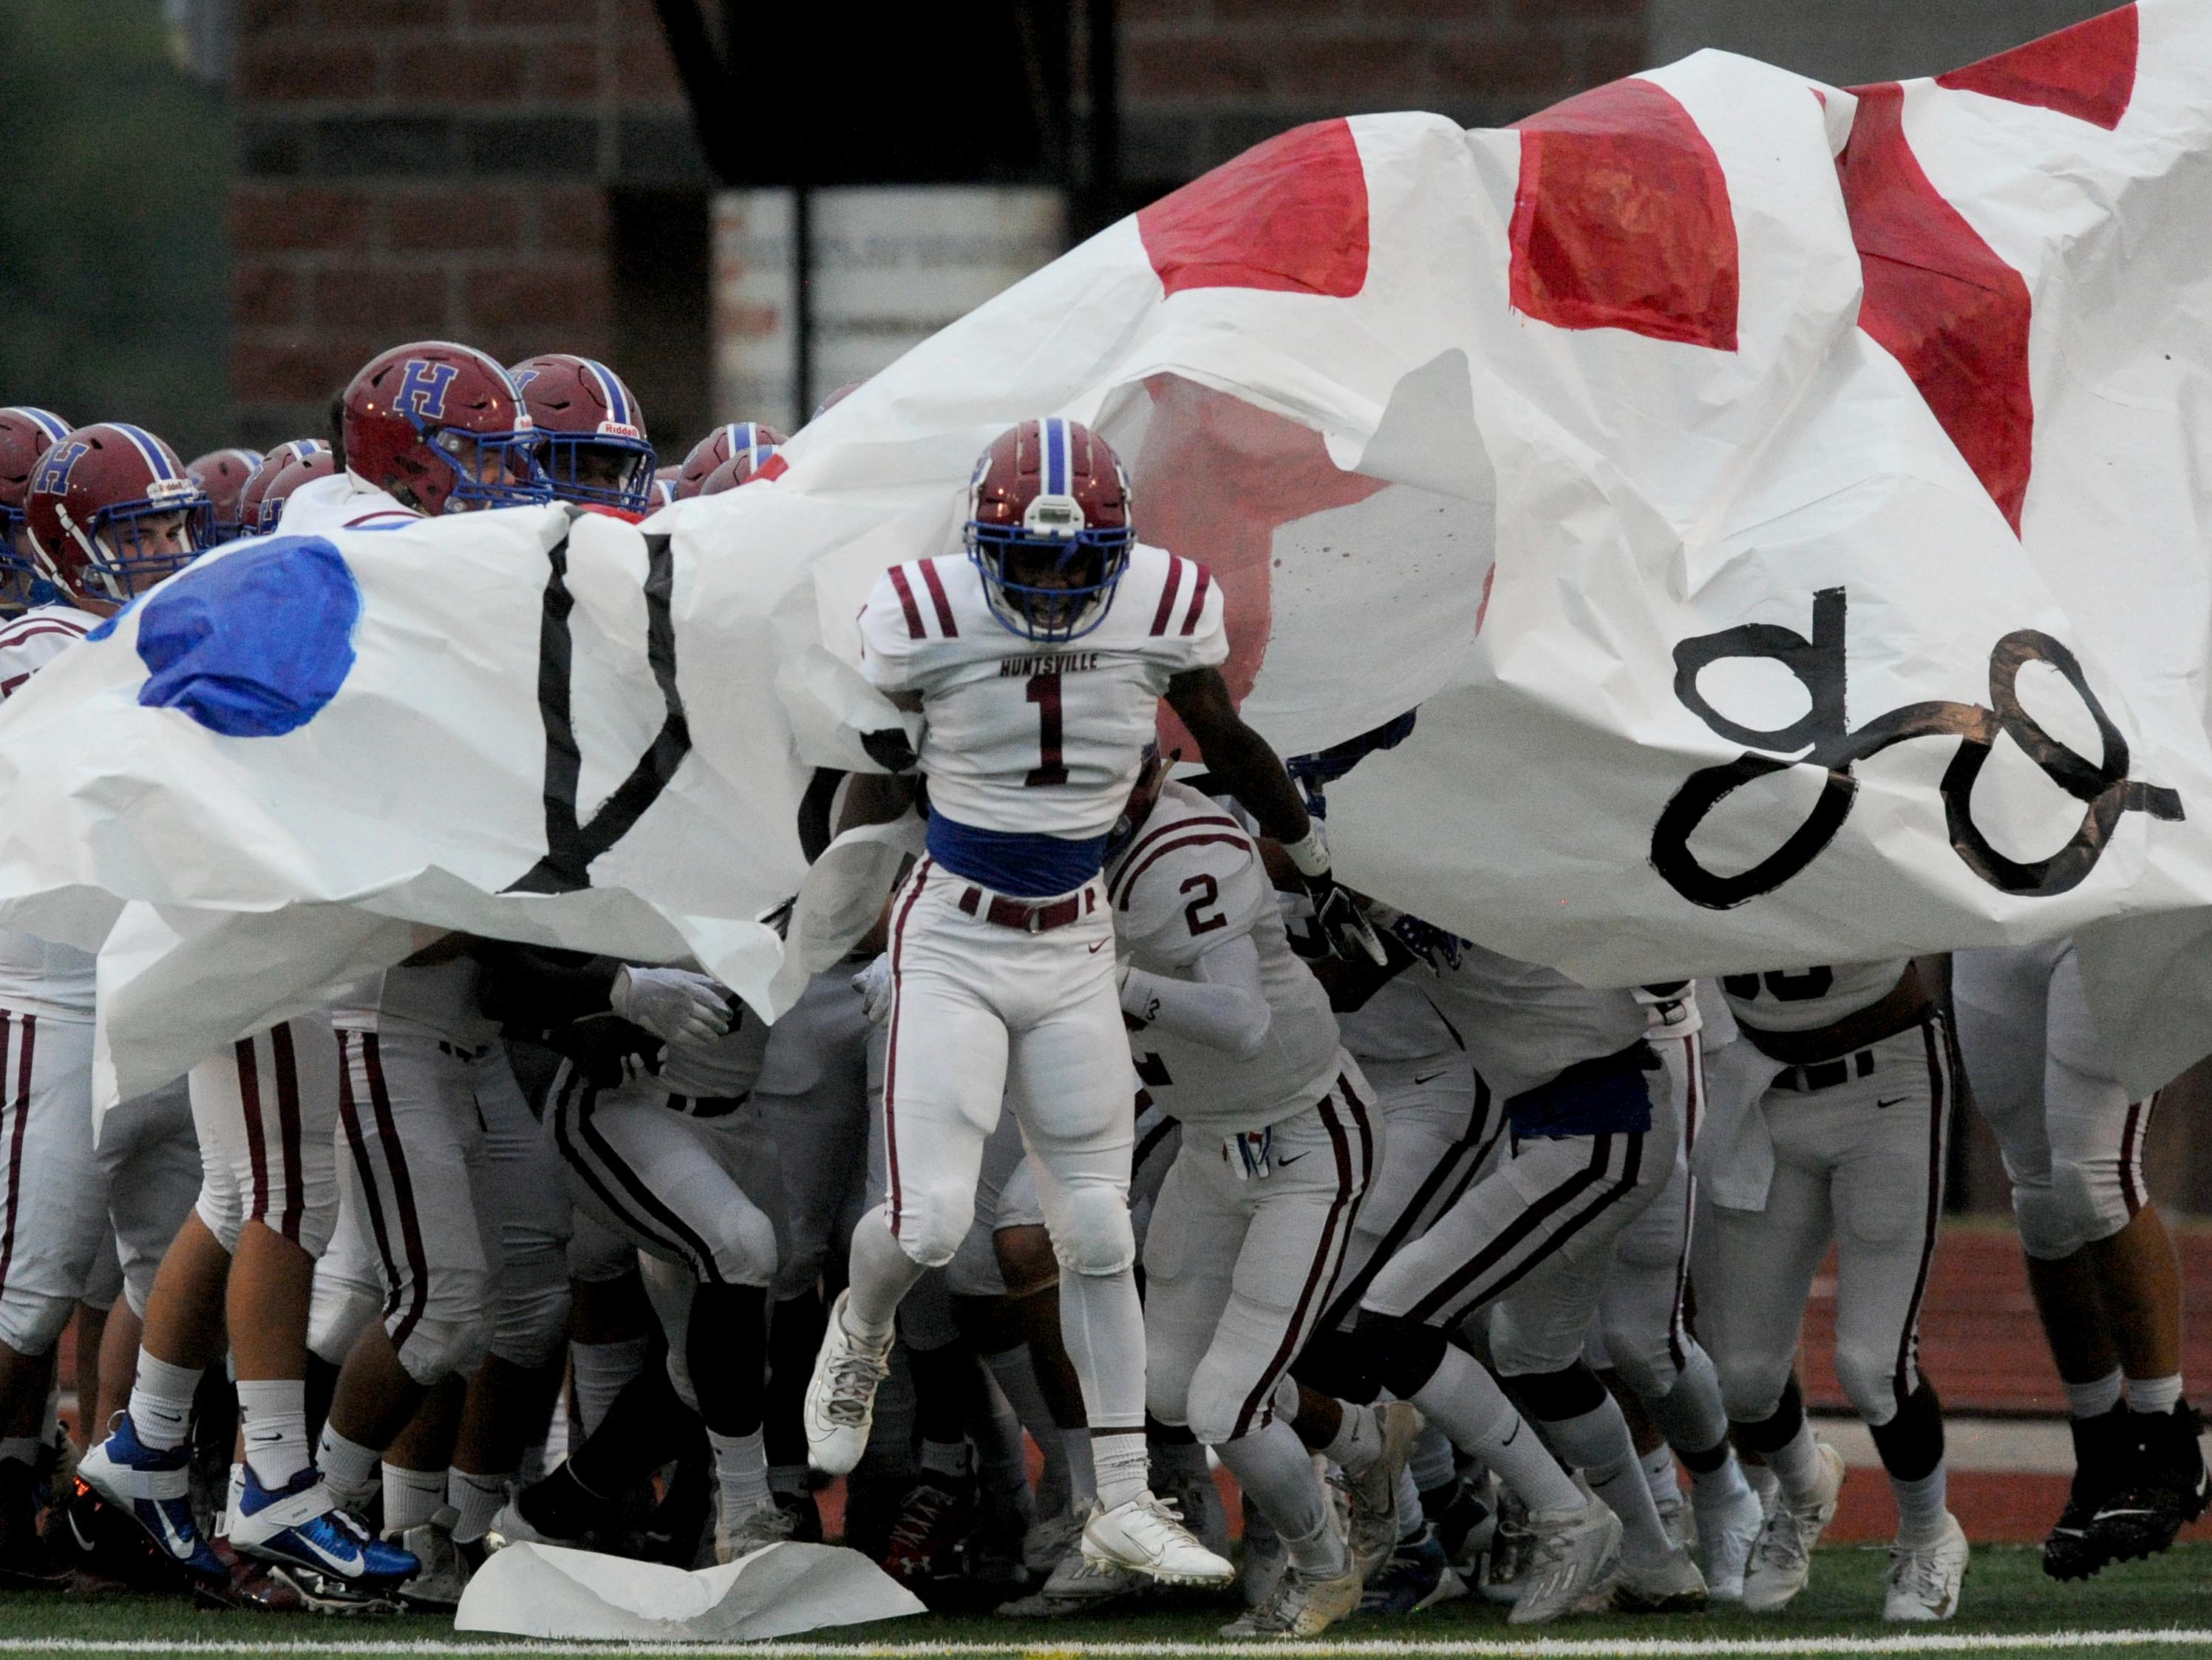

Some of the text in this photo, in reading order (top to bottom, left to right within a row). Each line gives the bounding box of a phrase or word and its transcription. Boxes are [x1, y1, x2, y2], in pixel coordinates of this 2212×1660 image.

[393, 360, 458, 419] H
[605, 423, 638, 438] Riddell
[35, 442, 89, 496] H
[999, 653, 1099, 677] HUNTSVILLE
[1025, 674, 1069, 786] 1
[1180, 874, 1228, 937] 2
